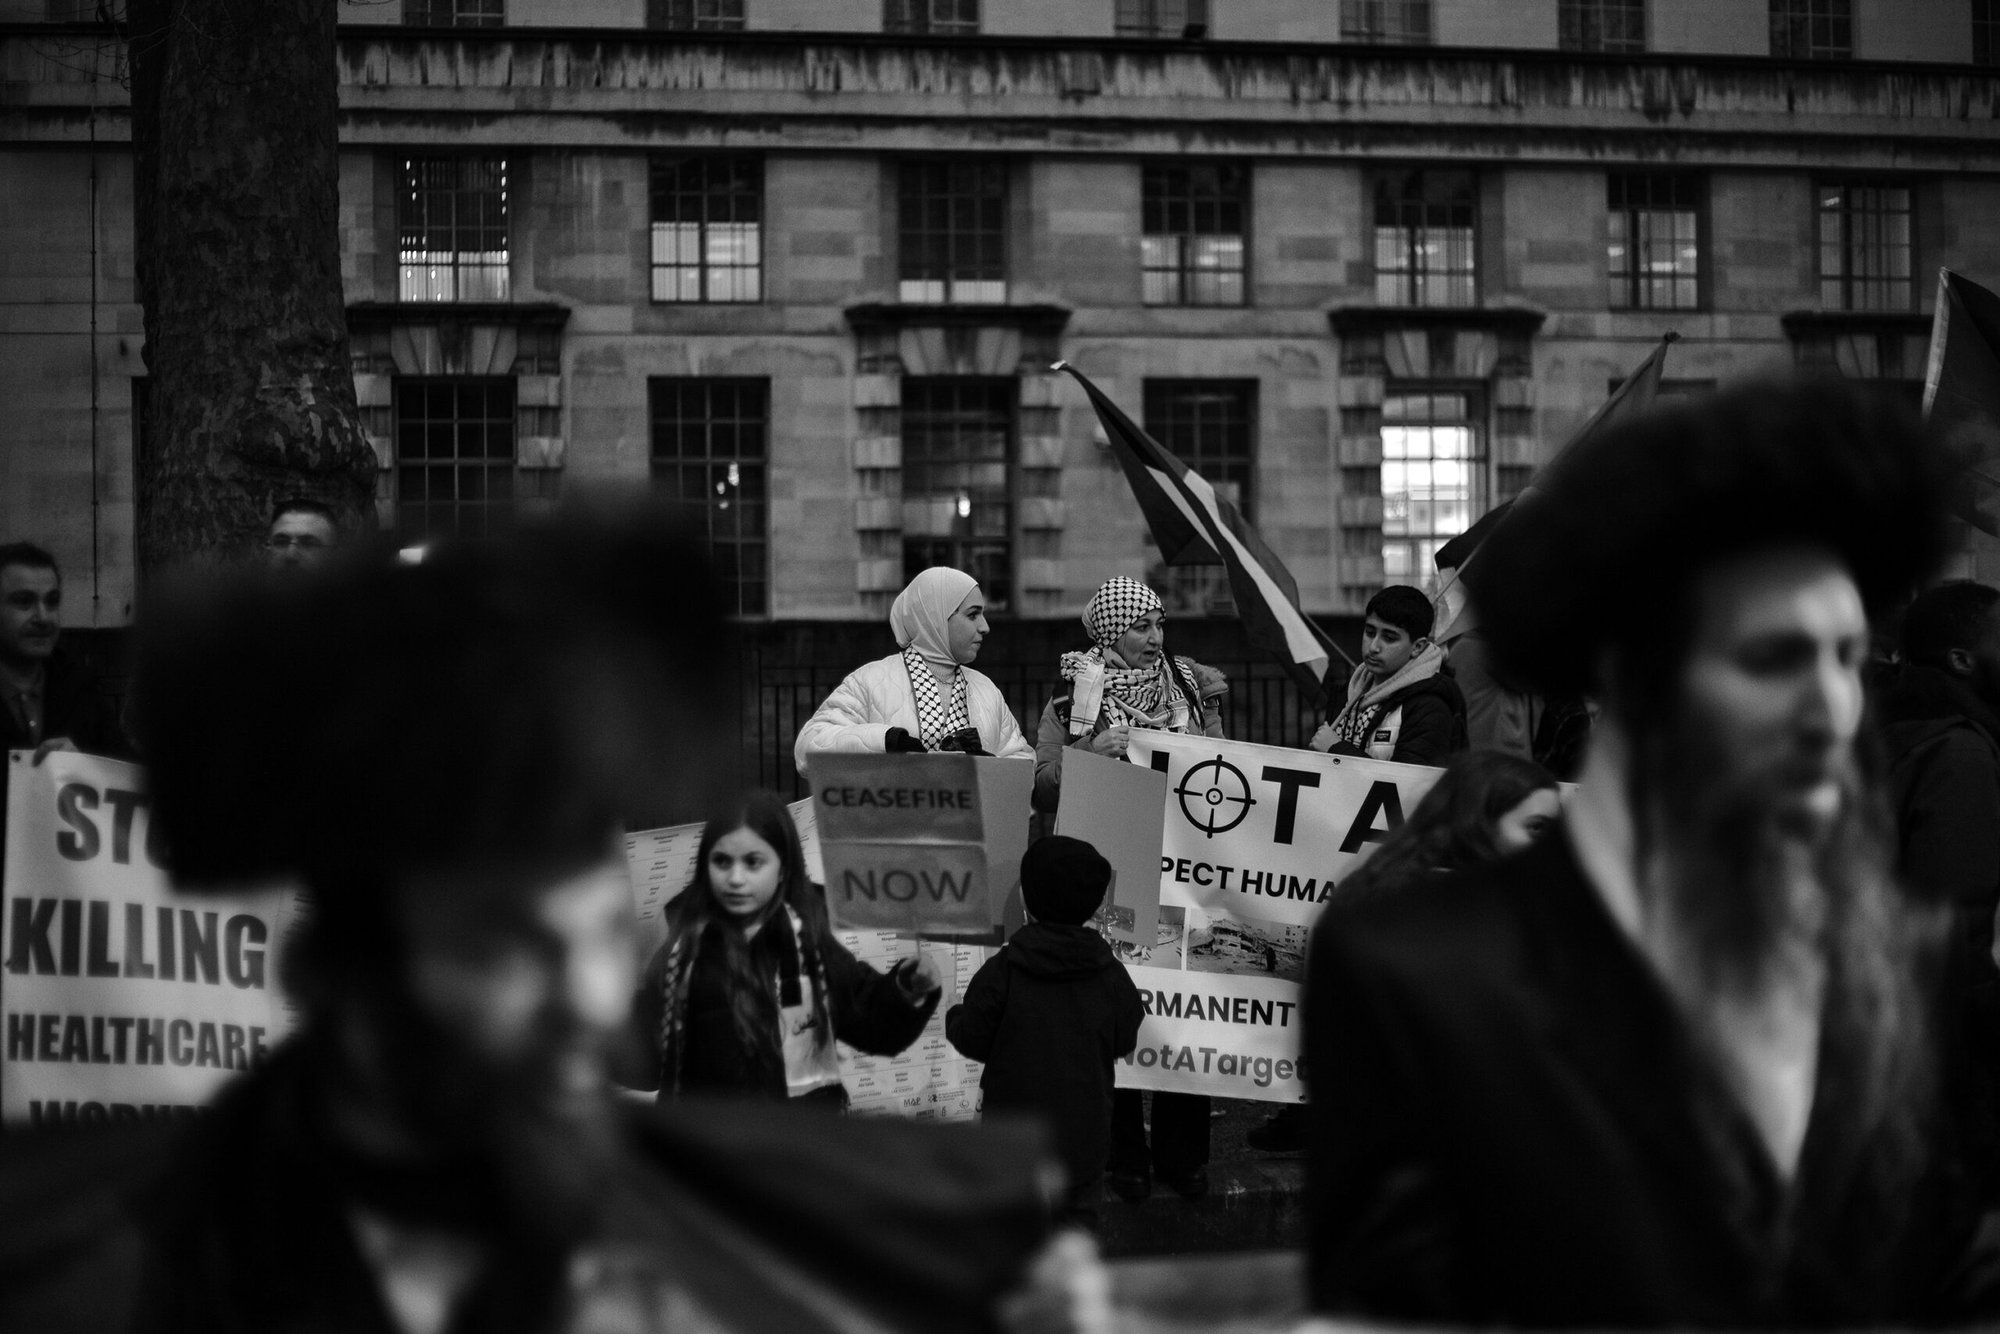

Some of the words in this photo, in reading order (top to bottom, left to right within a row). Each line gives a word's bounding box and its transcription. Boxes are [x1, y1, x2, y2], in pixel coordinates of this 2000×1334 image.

[56, 783, 168, 866] ST
[821, 787, 974, 809] CEASEFIRE
[1338, 780, 1406, 854] A
[843, 869, 972, 903] NOW
[9, 897, 267, 989] KILLING
[7, 1013, 266, 1071] HEALTHCARE
